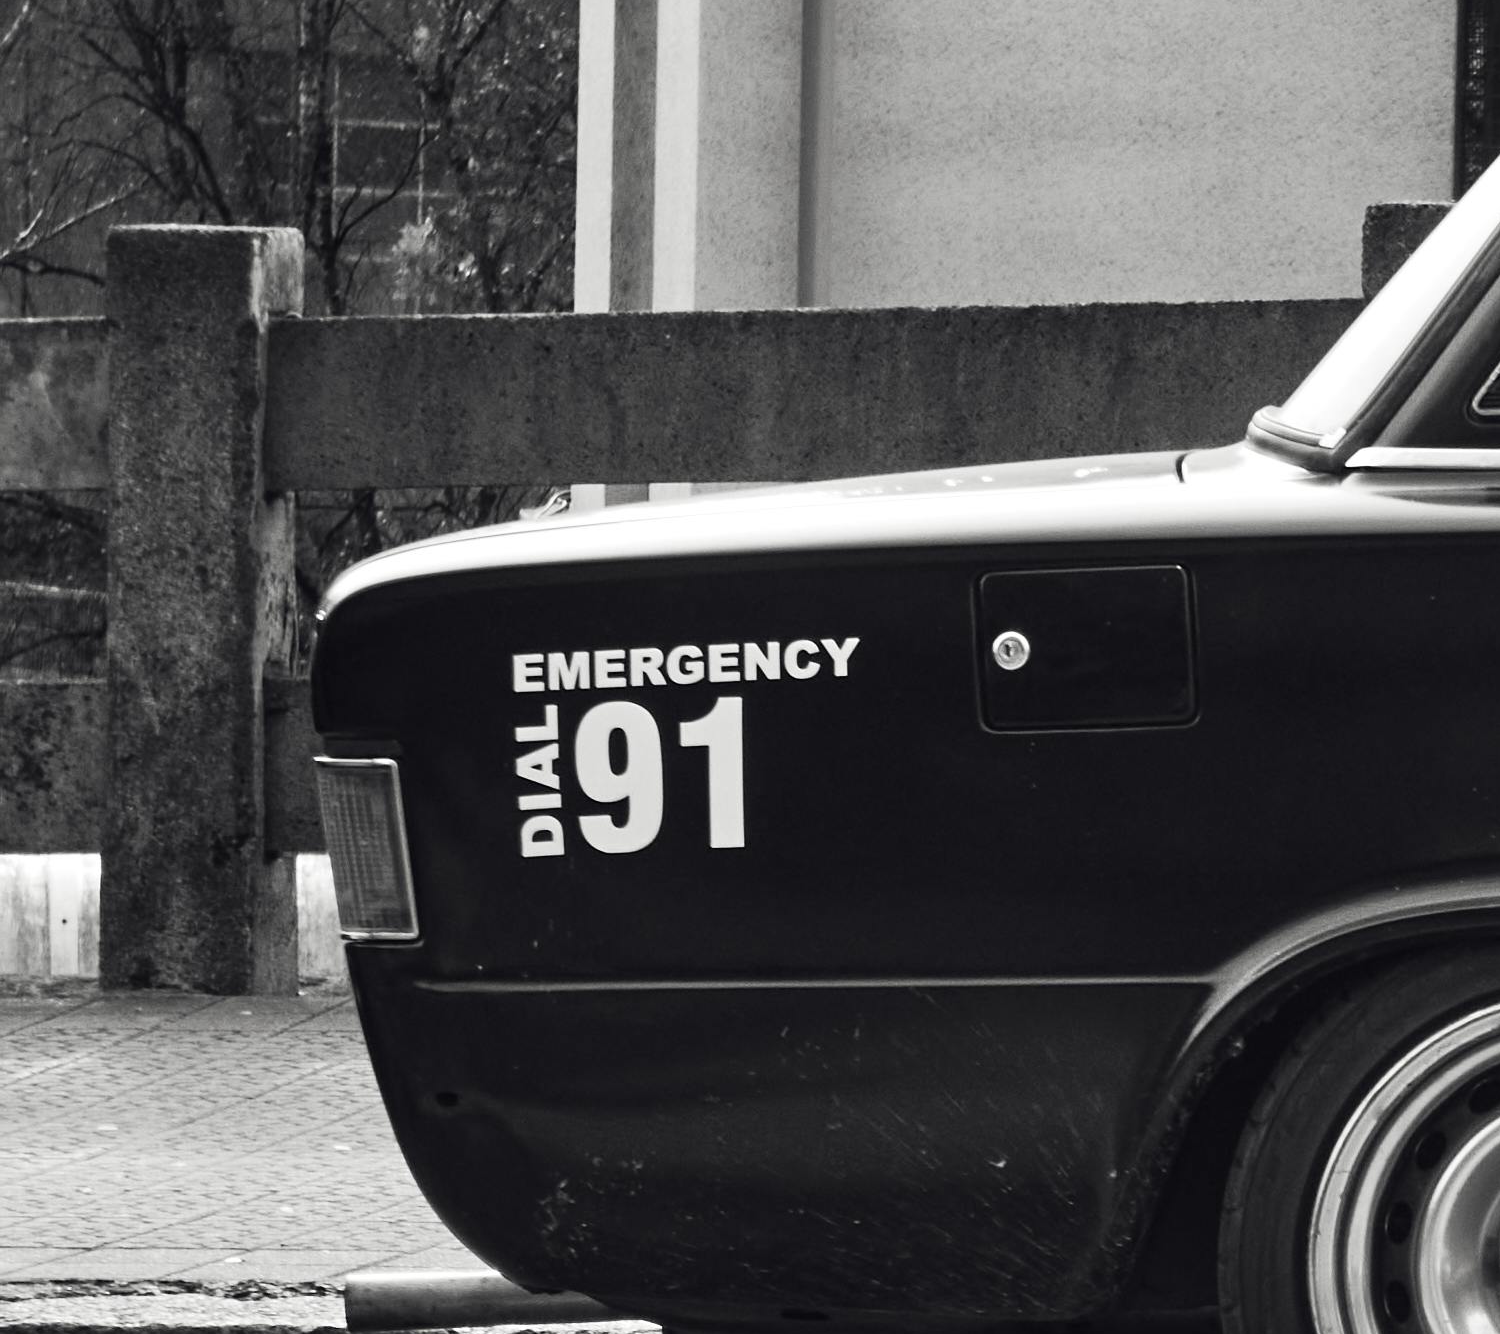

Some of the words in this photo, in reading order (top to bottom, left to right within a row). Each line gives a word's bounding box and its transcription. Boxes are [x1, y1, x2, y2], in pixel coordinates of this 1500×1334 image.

[512, 637, 861, 693] EMERGENCY
[514, 703, 566, 858] DIAL
[574, 696, 746, 855] 91
